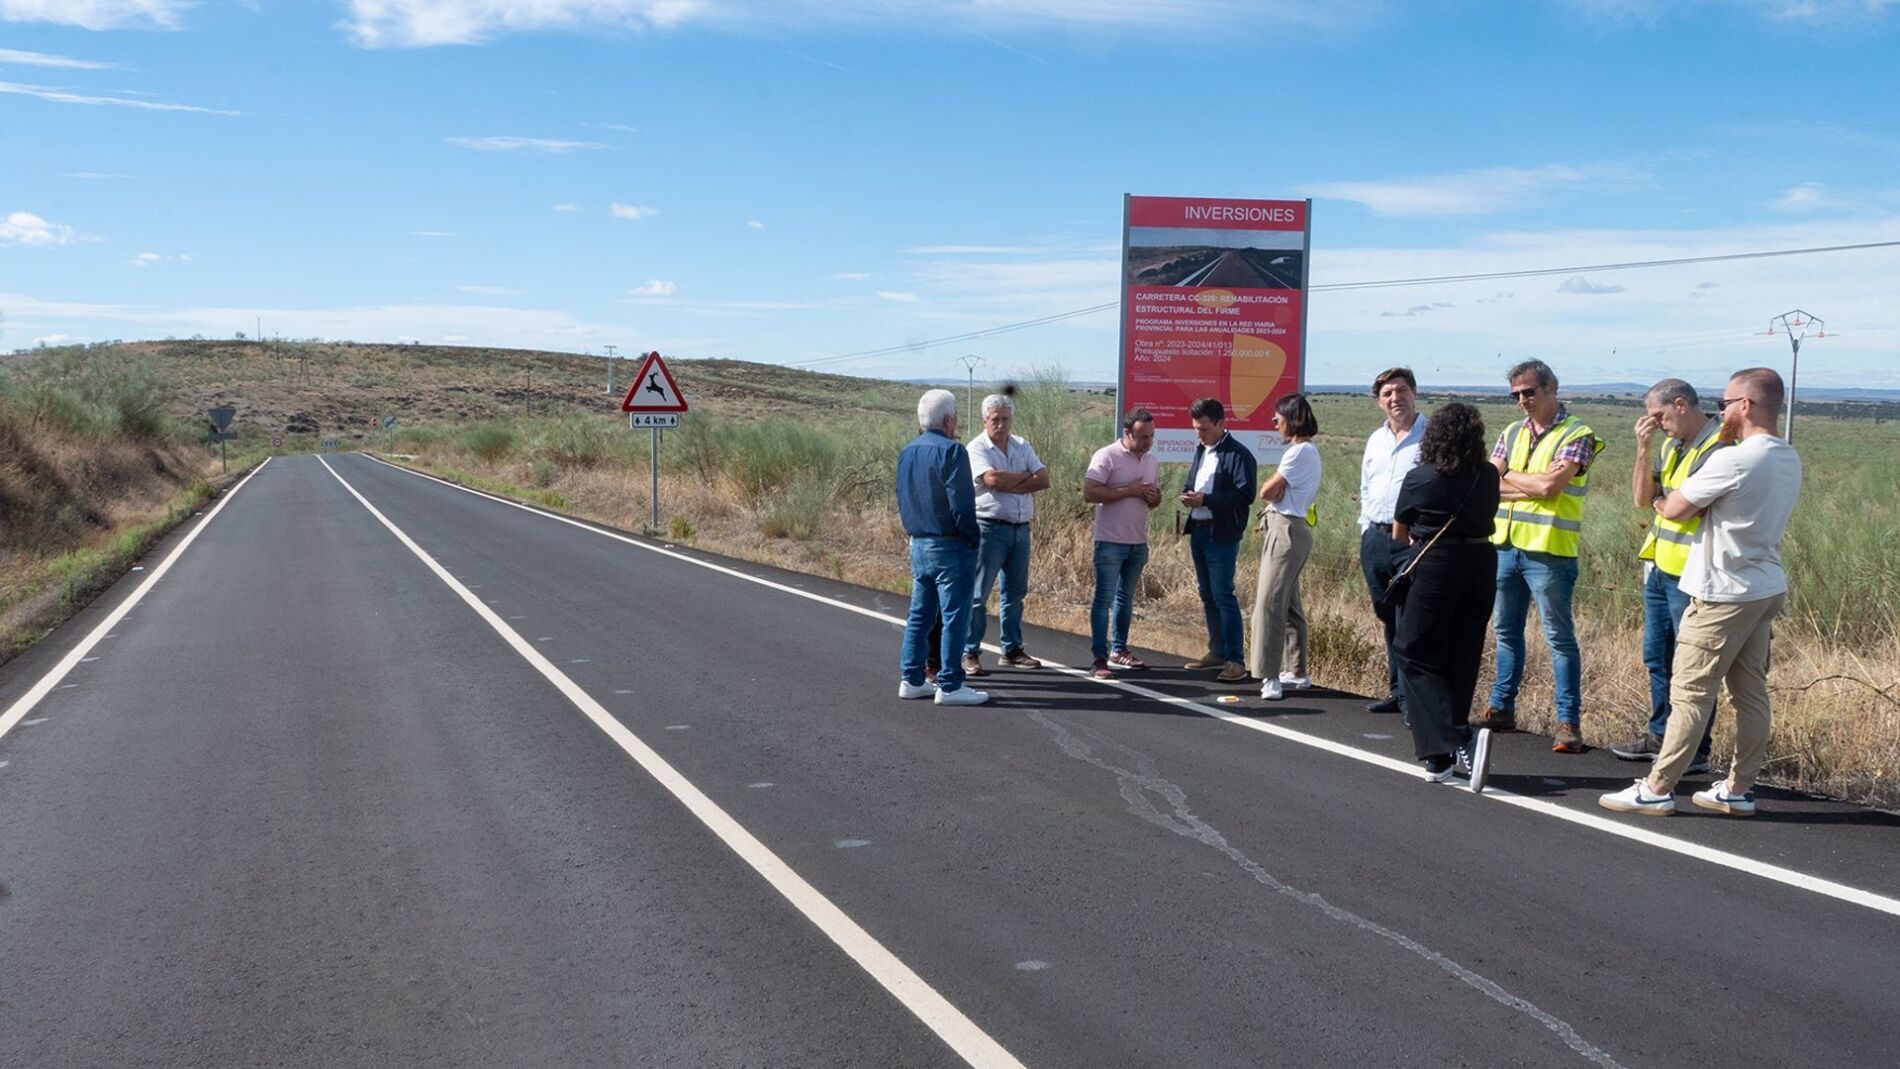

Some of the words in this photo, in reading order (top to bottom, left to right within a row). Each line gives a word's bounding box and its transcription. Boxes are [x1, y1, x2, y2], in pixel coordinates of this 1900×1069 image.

[1185, 206, 1295, 222] INVERSIONES
[1136, 293, 1186, 301] CARRETERA
[1220, 295, 1288, 304] REHABILITACIÓN
[1136, 305, 1195, 314] ESTRUCTURAL
[1215, 307, 1240, 315] FIRME
[1135, 340, 1154, 348] Obra
[1135, 347, 1181, 356] Presupuesto
[1134, 354, 1151, 362] Año:
[644, 416, 650, 425] 4
[653, 416, 666, 425] km
